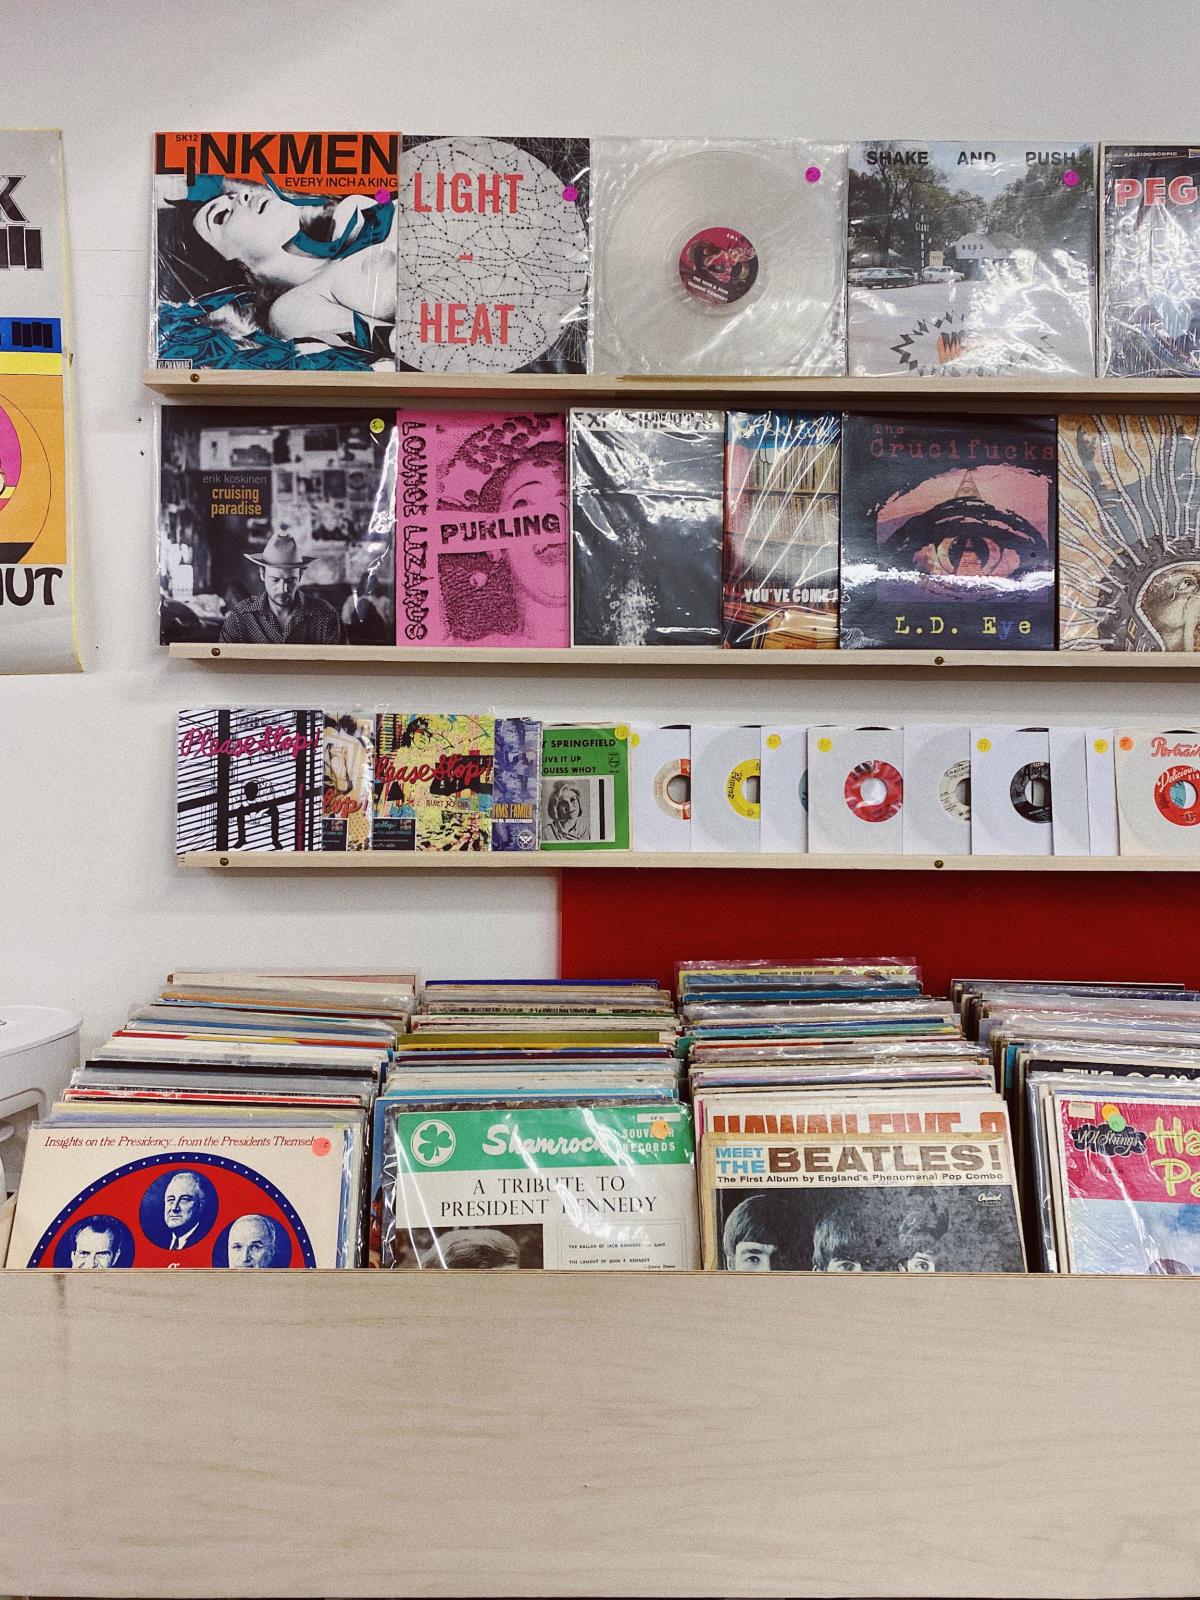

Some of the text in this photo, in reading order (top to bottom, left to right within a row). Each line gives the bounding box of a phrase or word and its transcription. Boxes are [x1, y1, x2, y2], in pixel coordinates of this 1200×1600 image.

[176, 134, 198, 142] SK12
[866, 151, 1076, 166] SHAKE AND PUSH
[285, 177, 398, 188] EVERY INCH A KING
[414, 173, 524, 214] LIGHT
[420, 303, 516, 345] HEAT
[875, 423, 904, 435] The
[870, 439, 1055, 461] Crucifucks
[203, 474, 267, 485] erik koskinen
[212, 486, 260, 503] cruising
[211, 500, 262, 518] paradise
[440, 513, 561, 545] PURLING
[402, 524, 428, 640] LIZARDS
[744, 588, 790, 603] YOU'VE
[792, 588, 830, 603] COME
[895, 616, 1032, 641] L.D. Eye
[551, 739, 616, 748] SPRINGFIELD
[374, 755, 434, 784] lease
[44, 1136, 83, 1148] Insights
[85, 1139, 98, 1147] on
[100, 1137, 115, 1147] the
[205, 1137, 219, 1147] the
[221, 1136, 272, 1147] Presidents
[273, 1135, 315, 1147] Themsel
[622, 1128, 674, 1139] SOUVR
[1098, 1129, 1138, 1154] Strings
[622, 1142, 676, 1153] RECORDS
[715, 1146, 763, 1158] MEET
[717, 1159, 766, 1174] THE
[768, 1144, 1000, 1173] BEATLES!
[473, 1175, 625, 1195] A TRIBUTE TO
[740, 1175, 763, 1183] First
[766, 1175, 799, 1183] Album
[803, 1175, 815, 1184] by
[818, 1173, 869, 1183] England's
[872, 1173, 938, 1181] Phenomenal
[942, 1173, 962, 1181] Pop
[965, 1171, 1004, 1180] Combo
[441, 1199, 549, 1217] PRESIDENT
